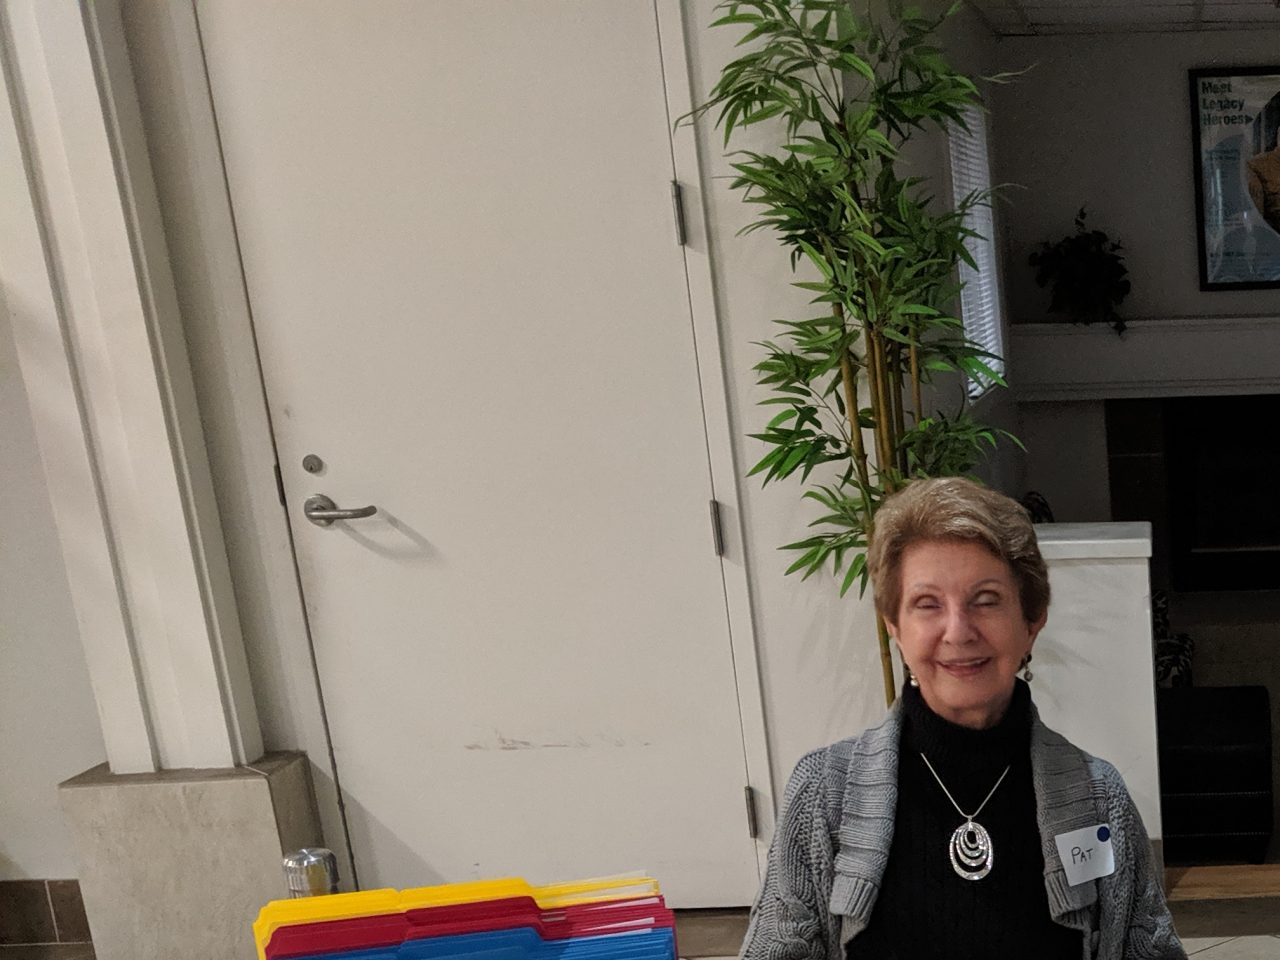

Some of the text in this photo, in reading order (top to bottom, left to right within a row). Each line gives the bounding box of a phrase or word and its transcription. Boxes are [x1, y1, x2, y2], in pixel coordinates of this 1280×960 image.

[1202, 81, 1232, 95] Meet
[1202, 97, 1245, 112] Legacy
[1203, 113, 1245, 126] Heroes
